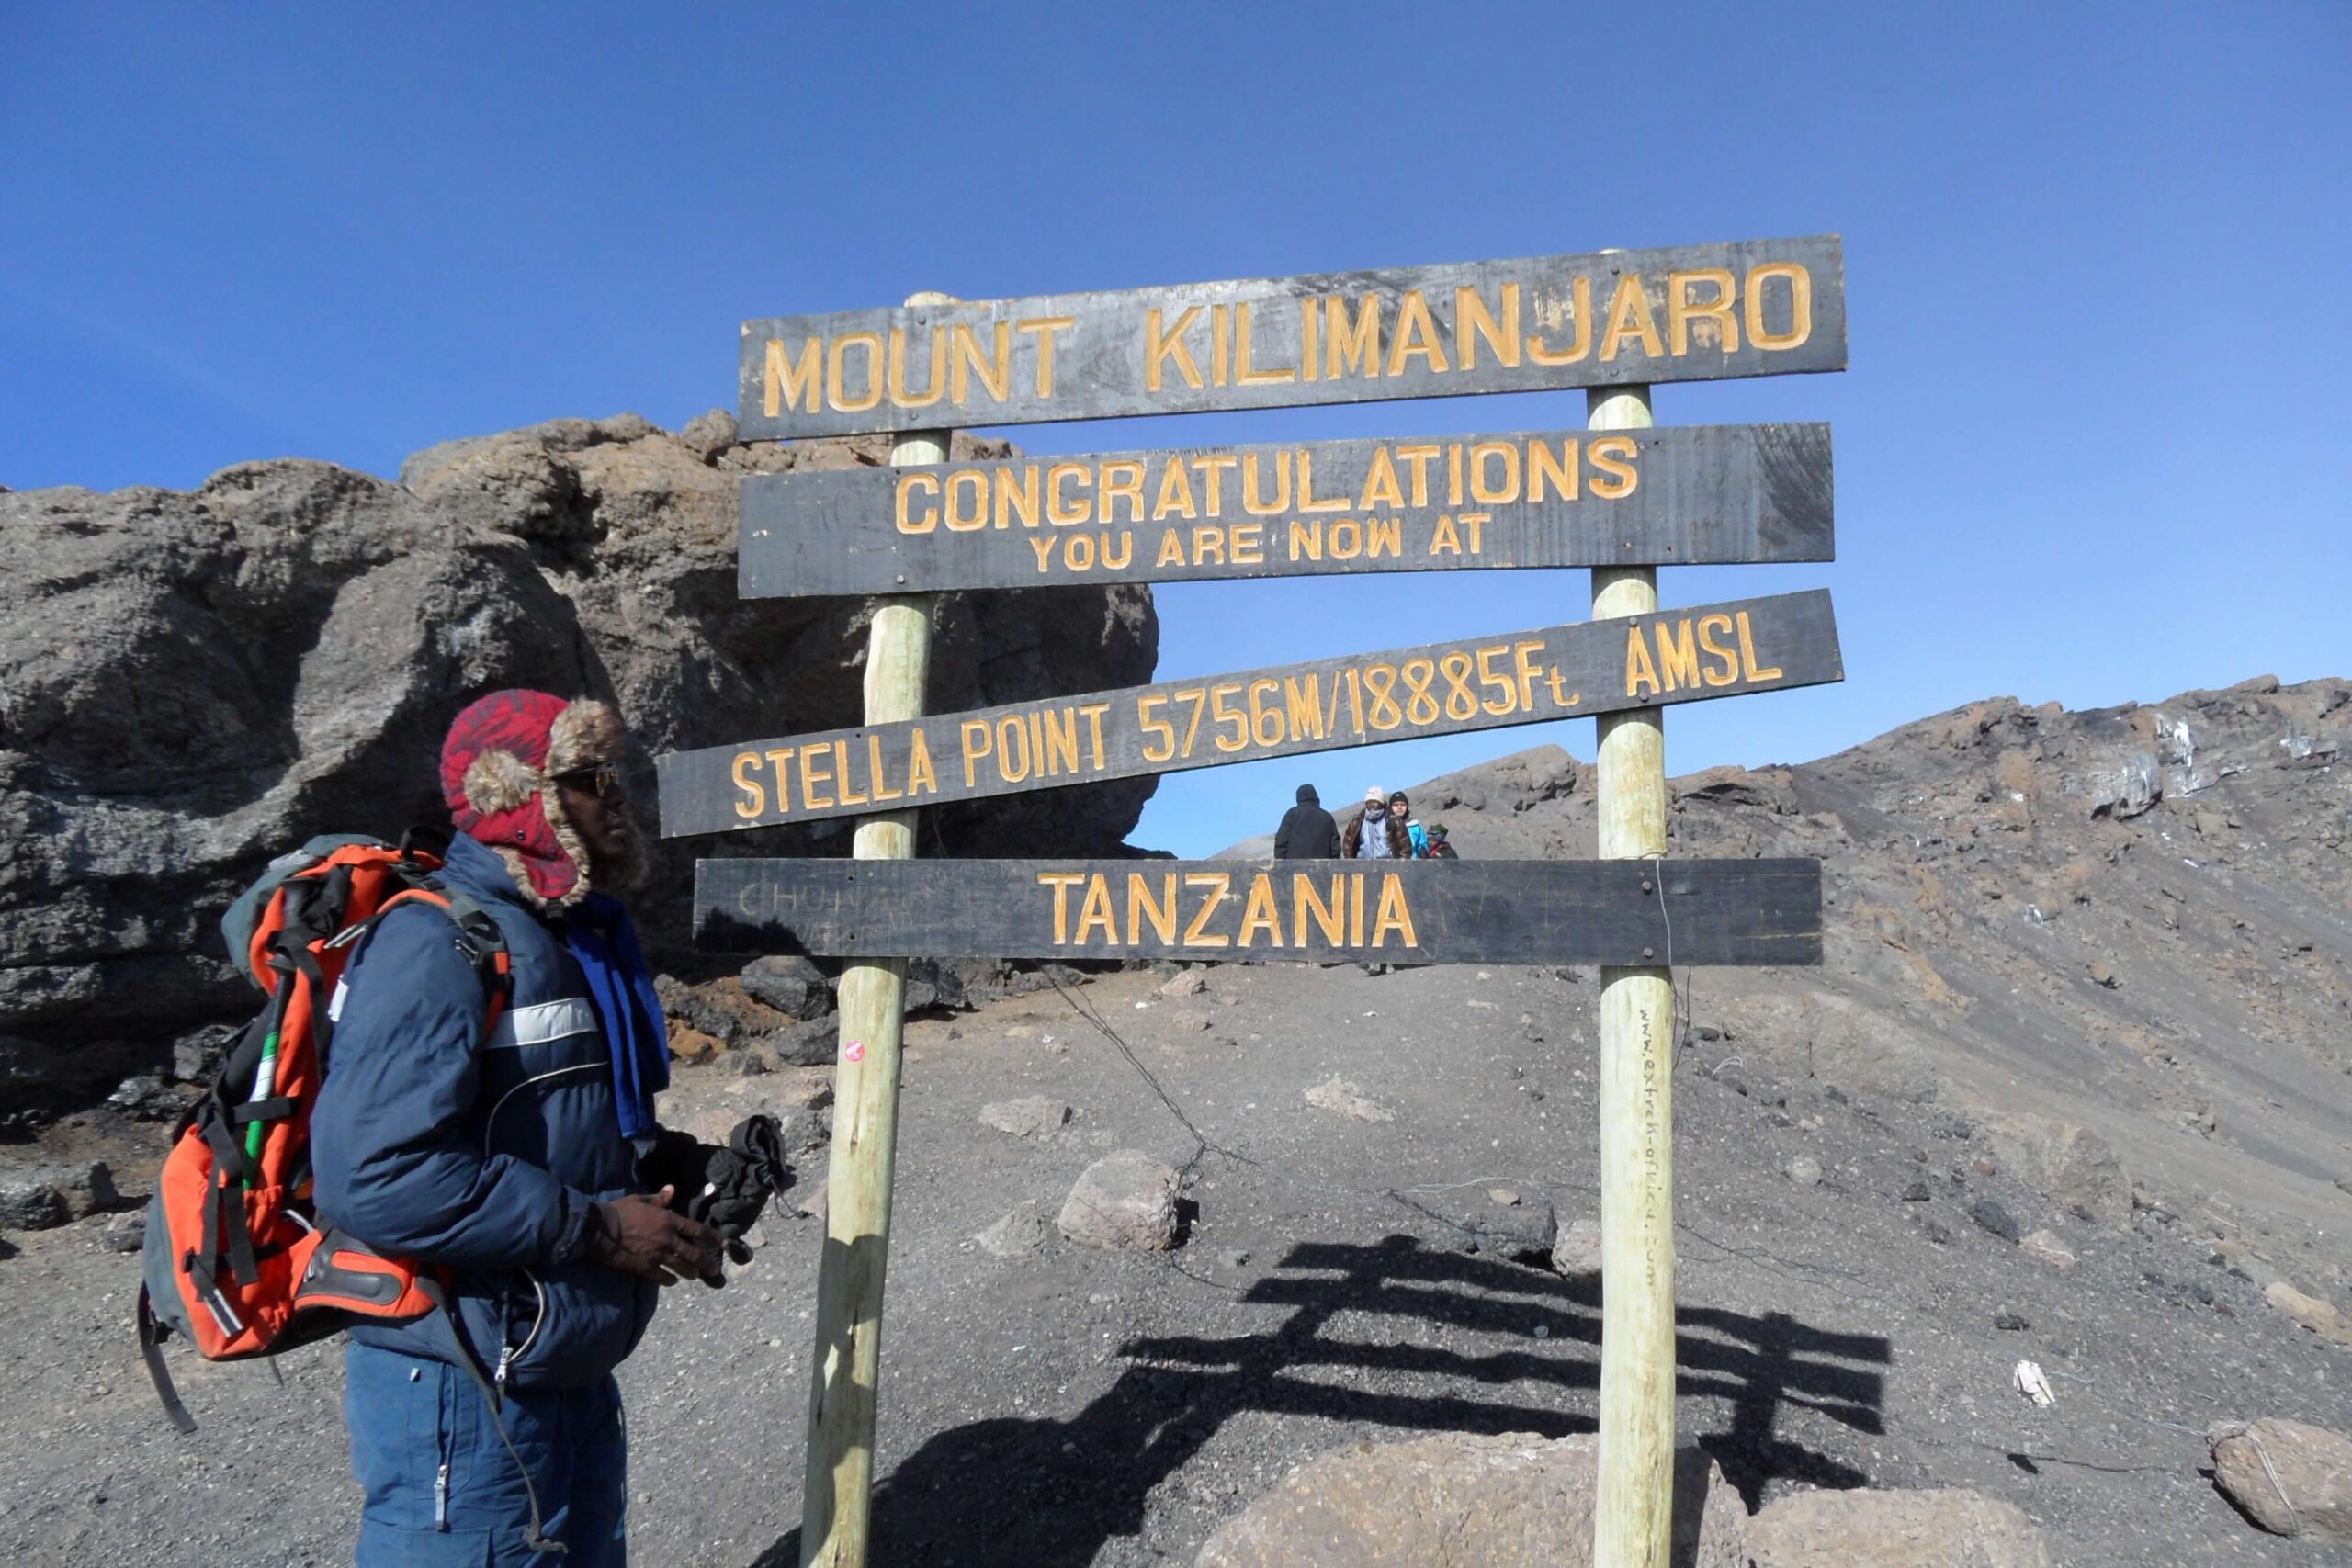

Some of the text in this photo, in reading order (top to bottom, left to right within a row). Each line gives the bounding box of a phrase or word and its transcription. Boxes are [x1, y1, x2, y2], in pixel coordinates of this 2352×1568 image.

[764, 262, 1811, 417] MOUNT KILIMANJARO
[895, 436, 1638, 535] CONGRATULATIONS
[1029, 513, 1491, 572] YOU ARE NOW AT
[732, 611, 1782, 819] STELLA POINT 5756M/18885Ft AMSL
[1037, 873, 1418, 948] TANZANIA
